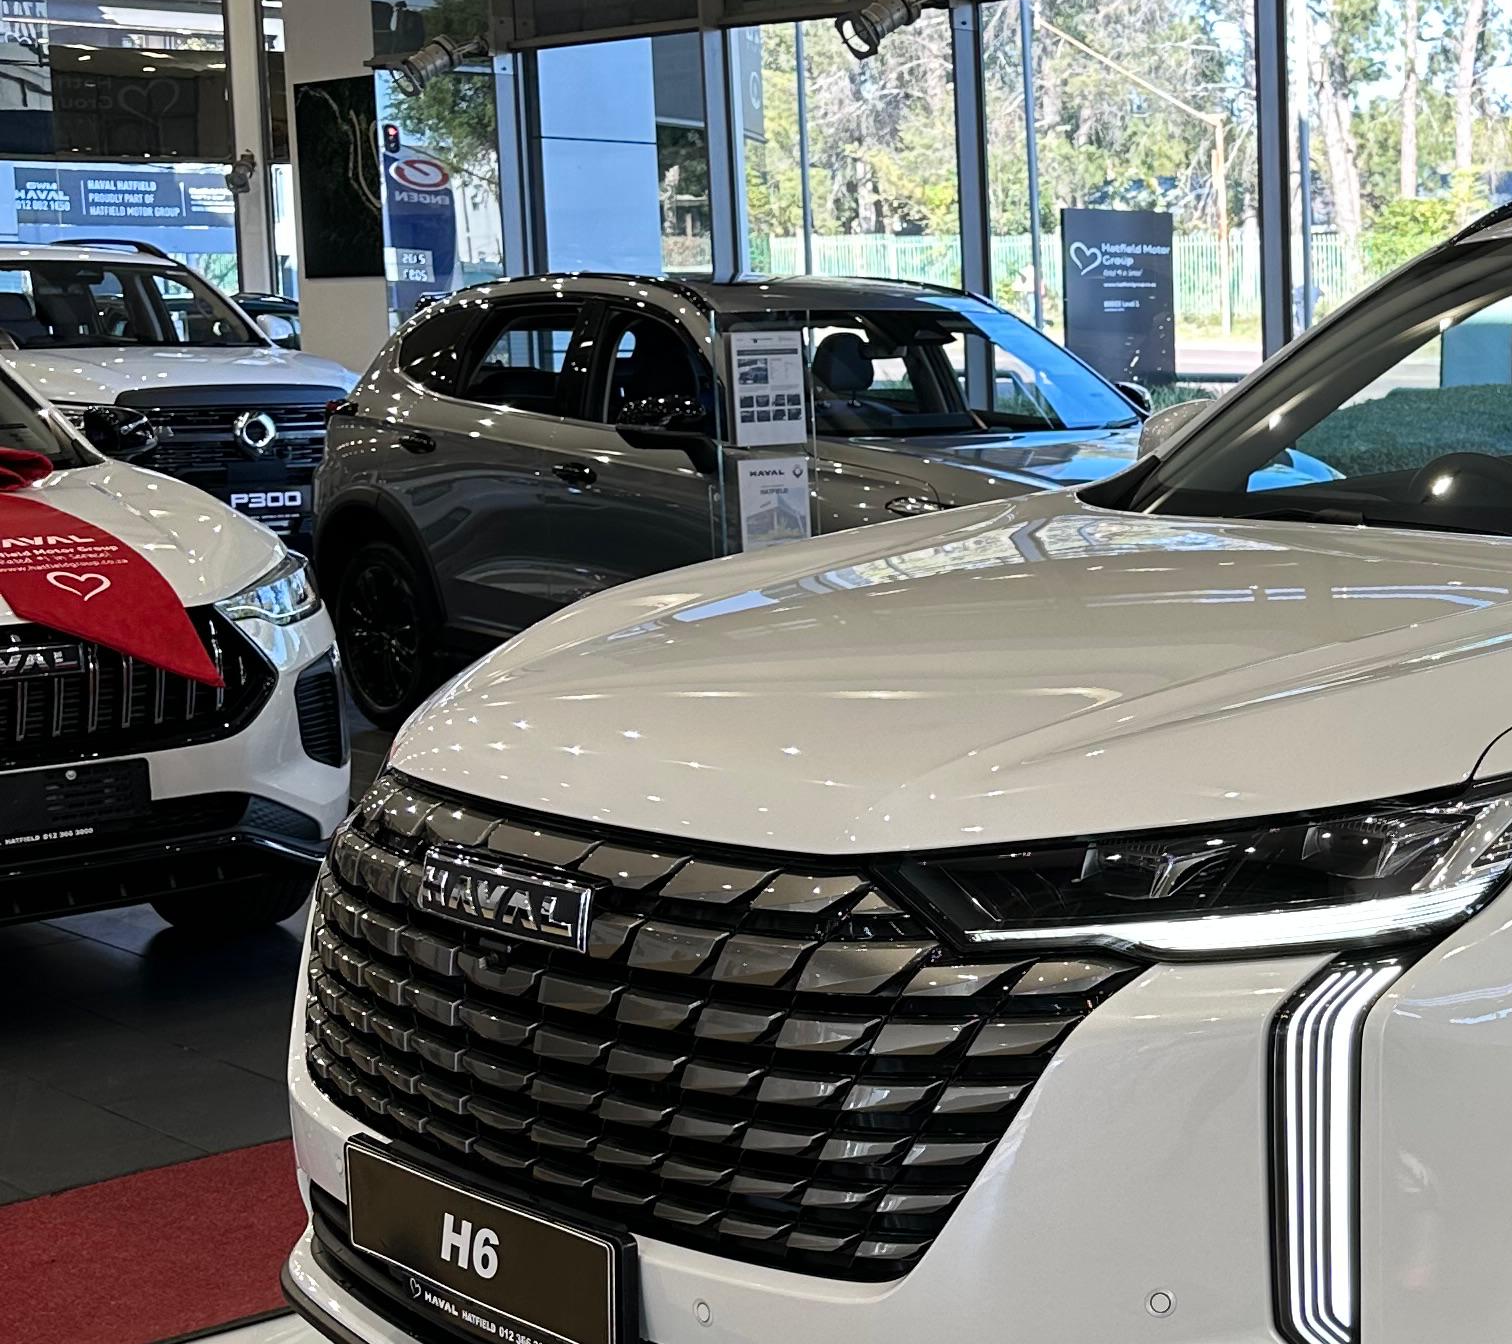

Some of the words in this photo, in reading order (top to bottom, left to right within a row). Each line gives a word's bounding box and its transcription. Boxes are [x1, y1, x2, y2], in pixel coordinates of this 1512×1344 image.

[87, 179, 116, 190] HAVAL
[116, 180, 157, 192] HATFIELD
[15, 189, 70, 201] HAVAL
[88, 193, 123, 204] PROUDLY
[123, 193, 143, 204] PART
[144, 194, 155, 204] OF
[89, 206, 126, 217] HATFIELD
[126, 207, 154, 217] MOTOR
[154, 207, 181, 217] GROUP
[1101, 243, 1142, 254] Hatfield
[1143, 244, 1170, 255] Motor
[1102, 255, 1134, 267] Group
[749, 469, 785, 478] HAVAL
[231, 491, 302, 508] P300
[2, 535, 95, 548] AVAL
[4, 835, 41, 846] HATFIELD
[421, 865, 573, 938] HAVAL
[441, 1212, 500, 1279] H6
[424, 1290, 459, 1317] HAVAL
[461, 1309, 497, 1334] HATFIELD
[498, 1325, 515, 1342] 012
